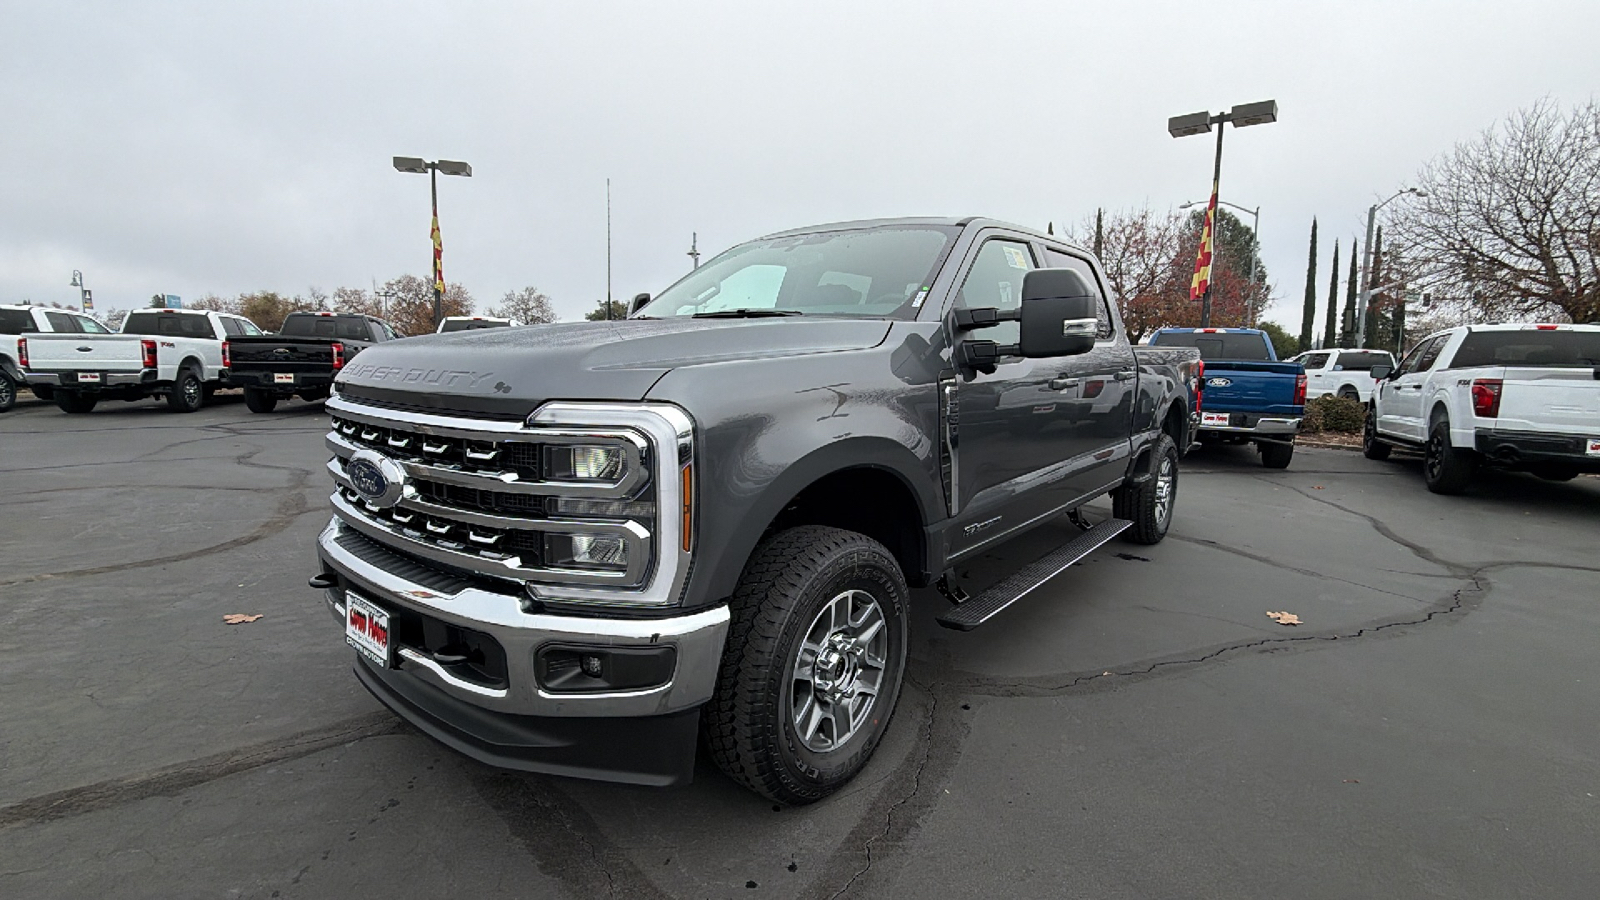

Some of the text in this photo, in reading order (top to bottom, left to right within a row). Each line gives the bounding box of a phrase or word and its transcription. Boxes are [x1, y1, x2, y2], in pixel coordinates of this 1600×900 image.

[342, 363, 494, 388] SUPER DUTY
[353, 464, 379, 493] Ford
[364, 649, 384, 667] MOTORS
